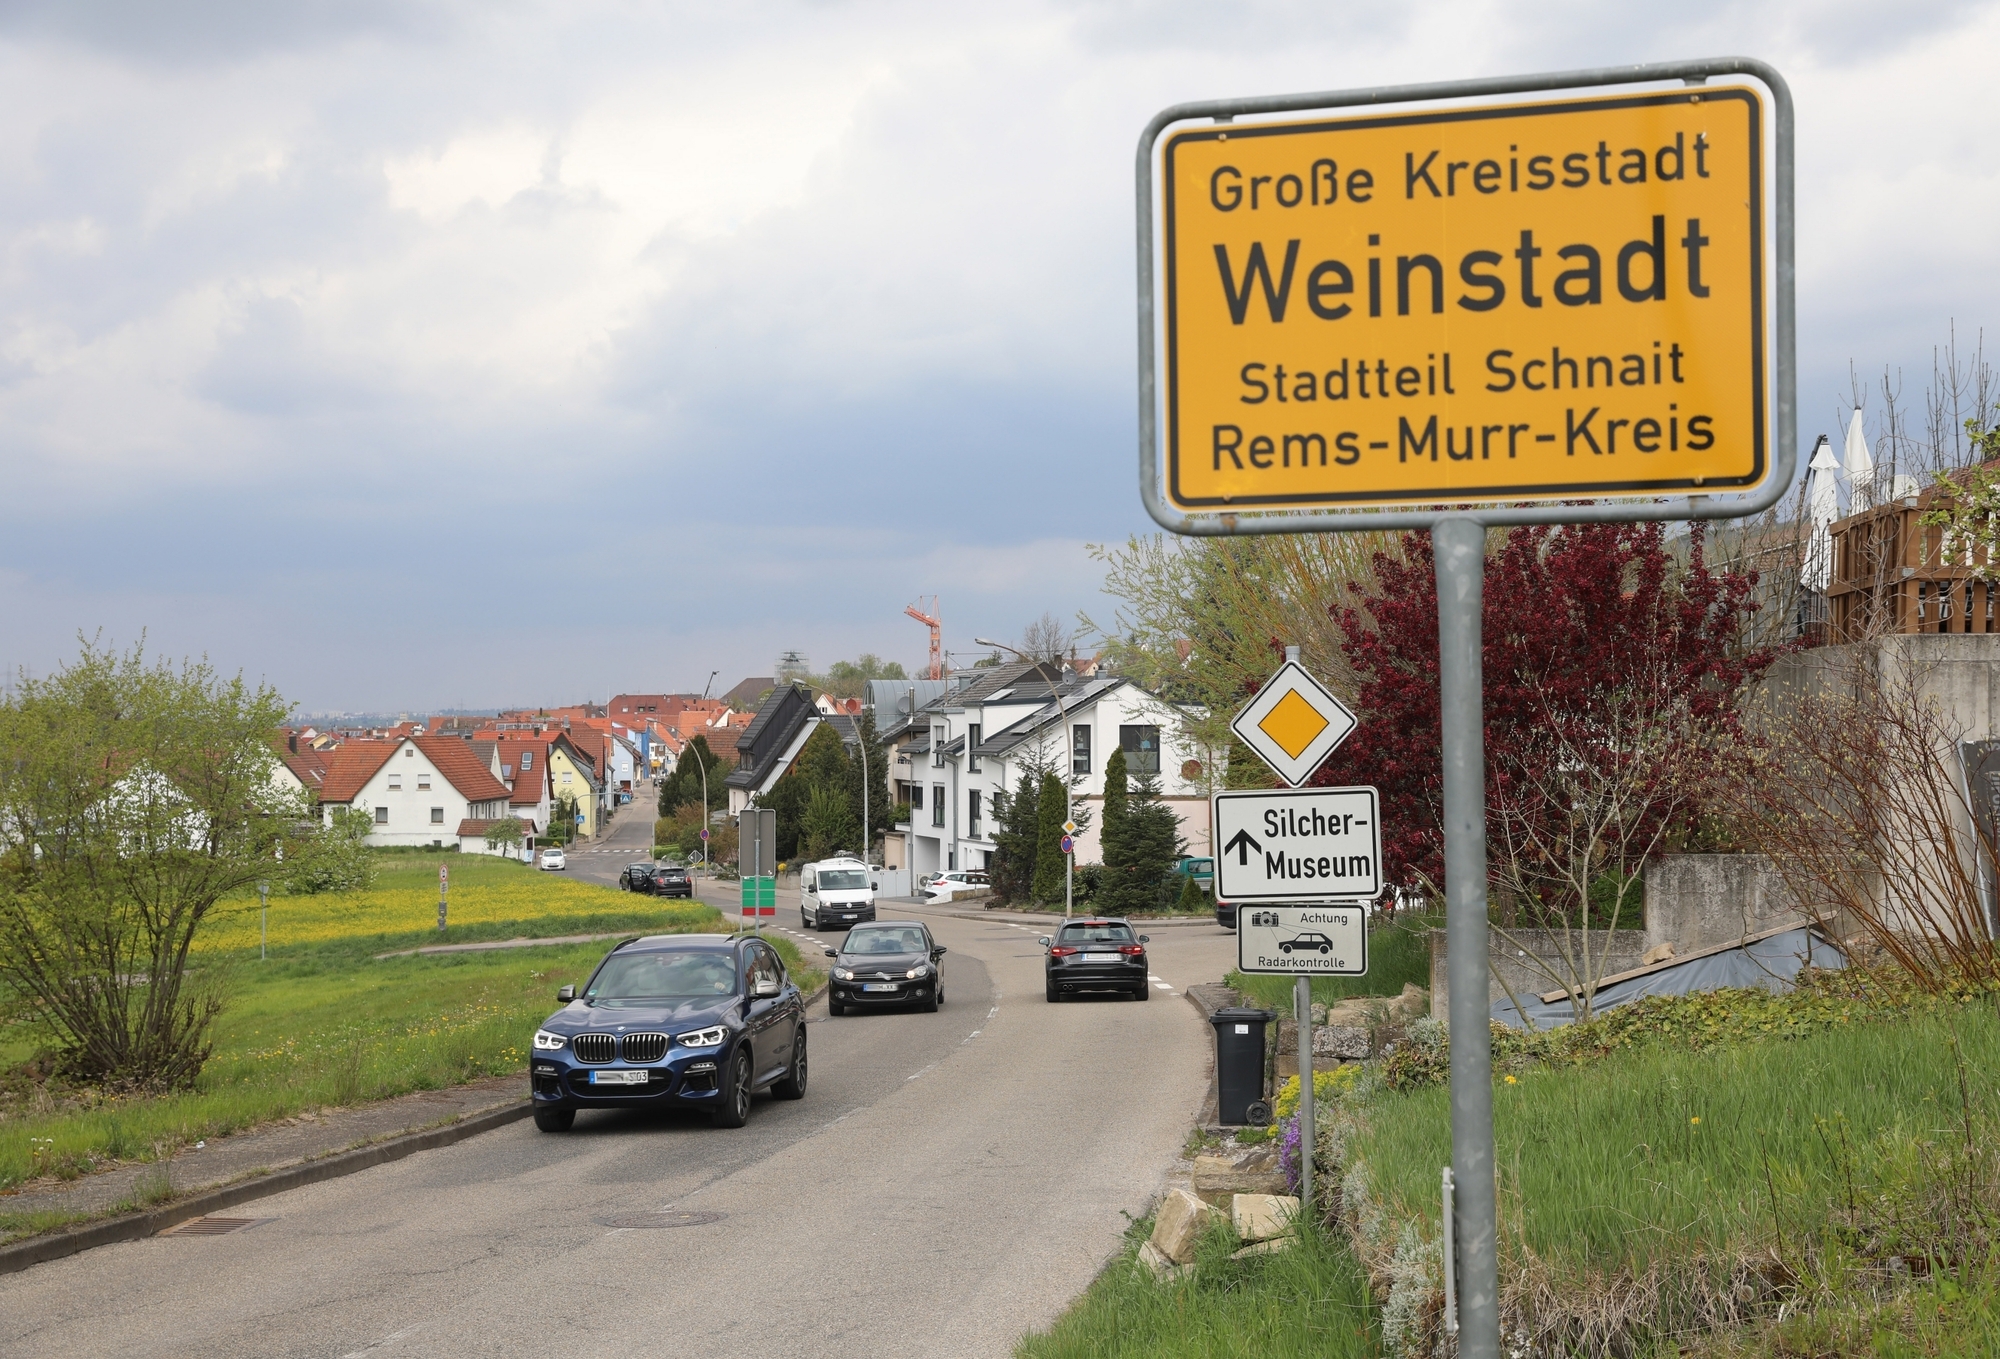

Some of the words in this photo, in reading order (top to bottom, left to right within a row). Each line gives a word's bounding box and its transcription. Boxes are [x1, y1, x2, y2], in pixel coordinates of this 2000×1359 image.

[1210, 158, 1374, 213] Große
[1405, 131, 1710, 200] Kreisstadt
[1213, 214, 1710, 326] Weinstadt
[1240, 352, 1455, 405] Stadtteil
[1485, 341, 1685, 393] Schnait
[1212, 403, 1715, 471] Rems-Murr-Kreis
[1264, 807, 1368, 838] Silcher-
[1265, 850, 1371, 880] Museum
[1300, 912, 1348, 927] Achtung
[1258, 955, 1345, 968] Radarkontrolle
